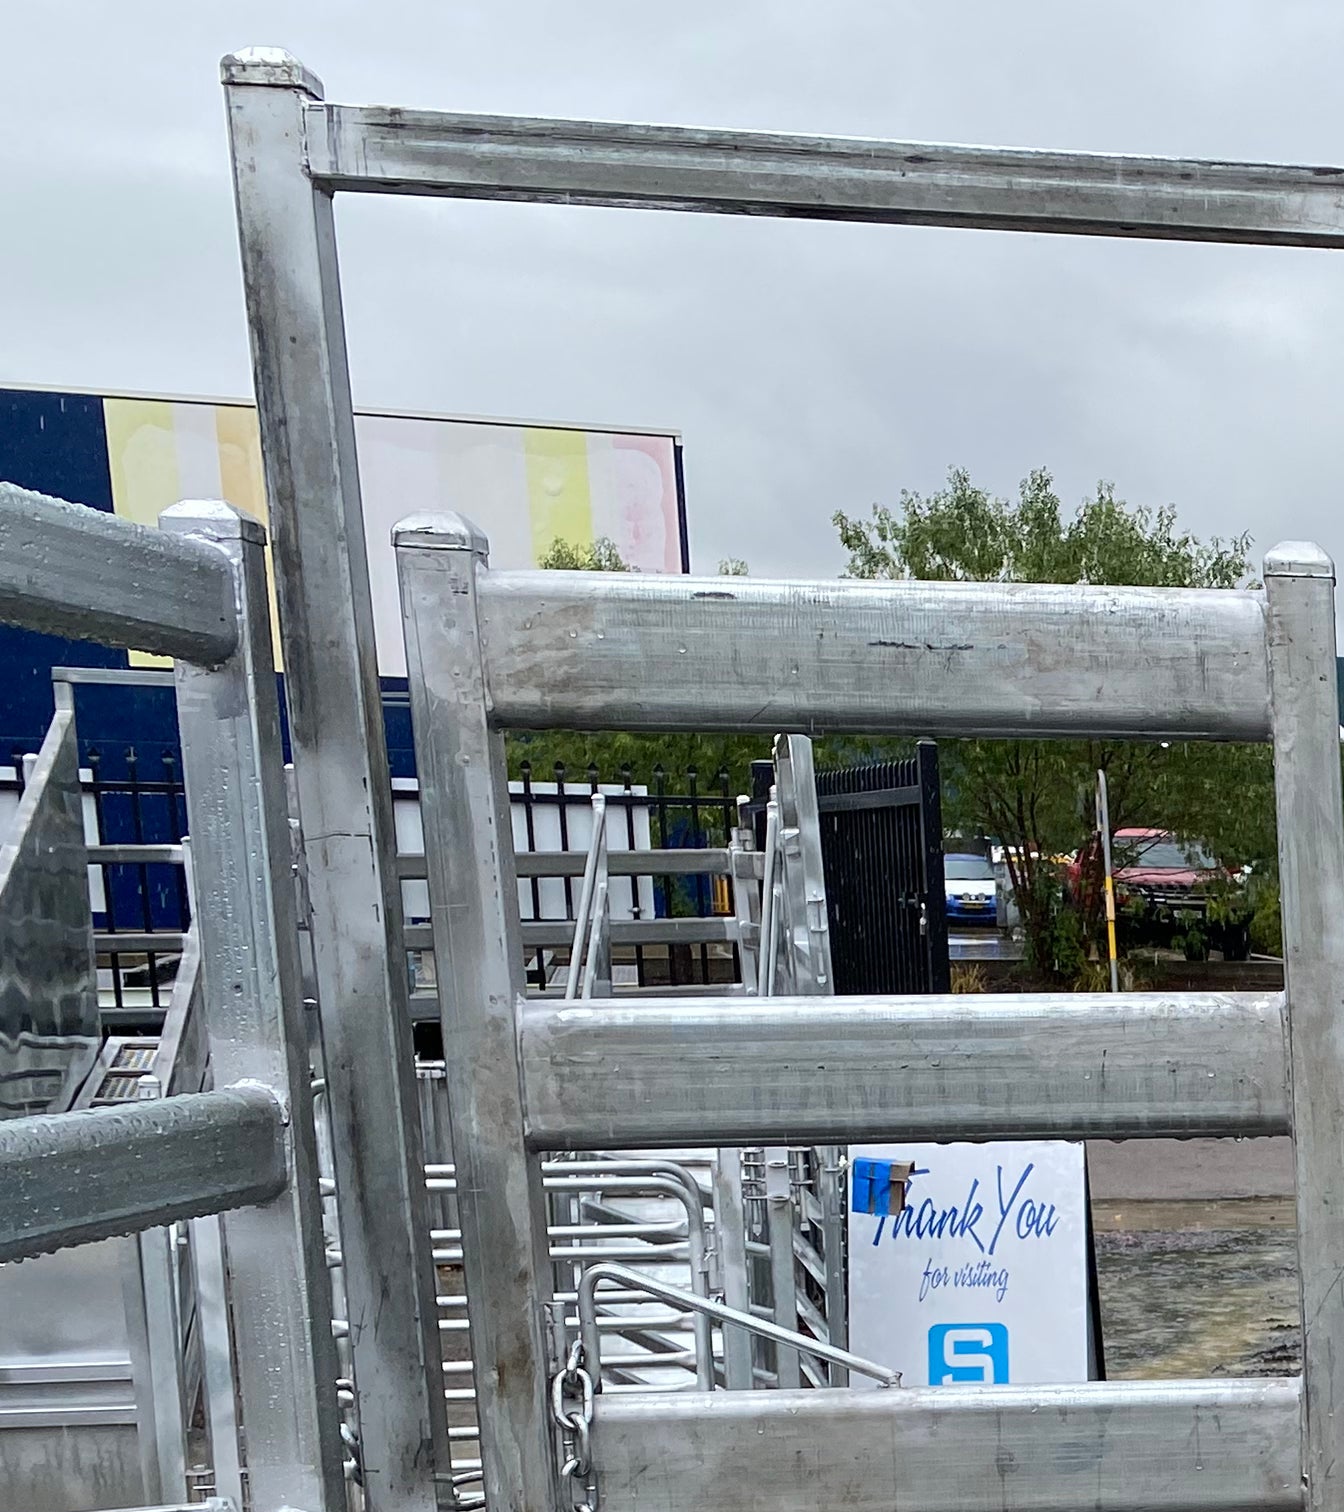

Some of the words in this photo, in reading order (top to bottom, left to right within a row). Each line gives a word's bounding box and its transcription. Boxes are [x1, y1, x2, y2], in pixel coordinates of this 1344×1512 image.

[987, 1163, 1060, 1255] You
[919, 1258, 952, 1302] for
[954, 1260, 1009, 1302] visiting
